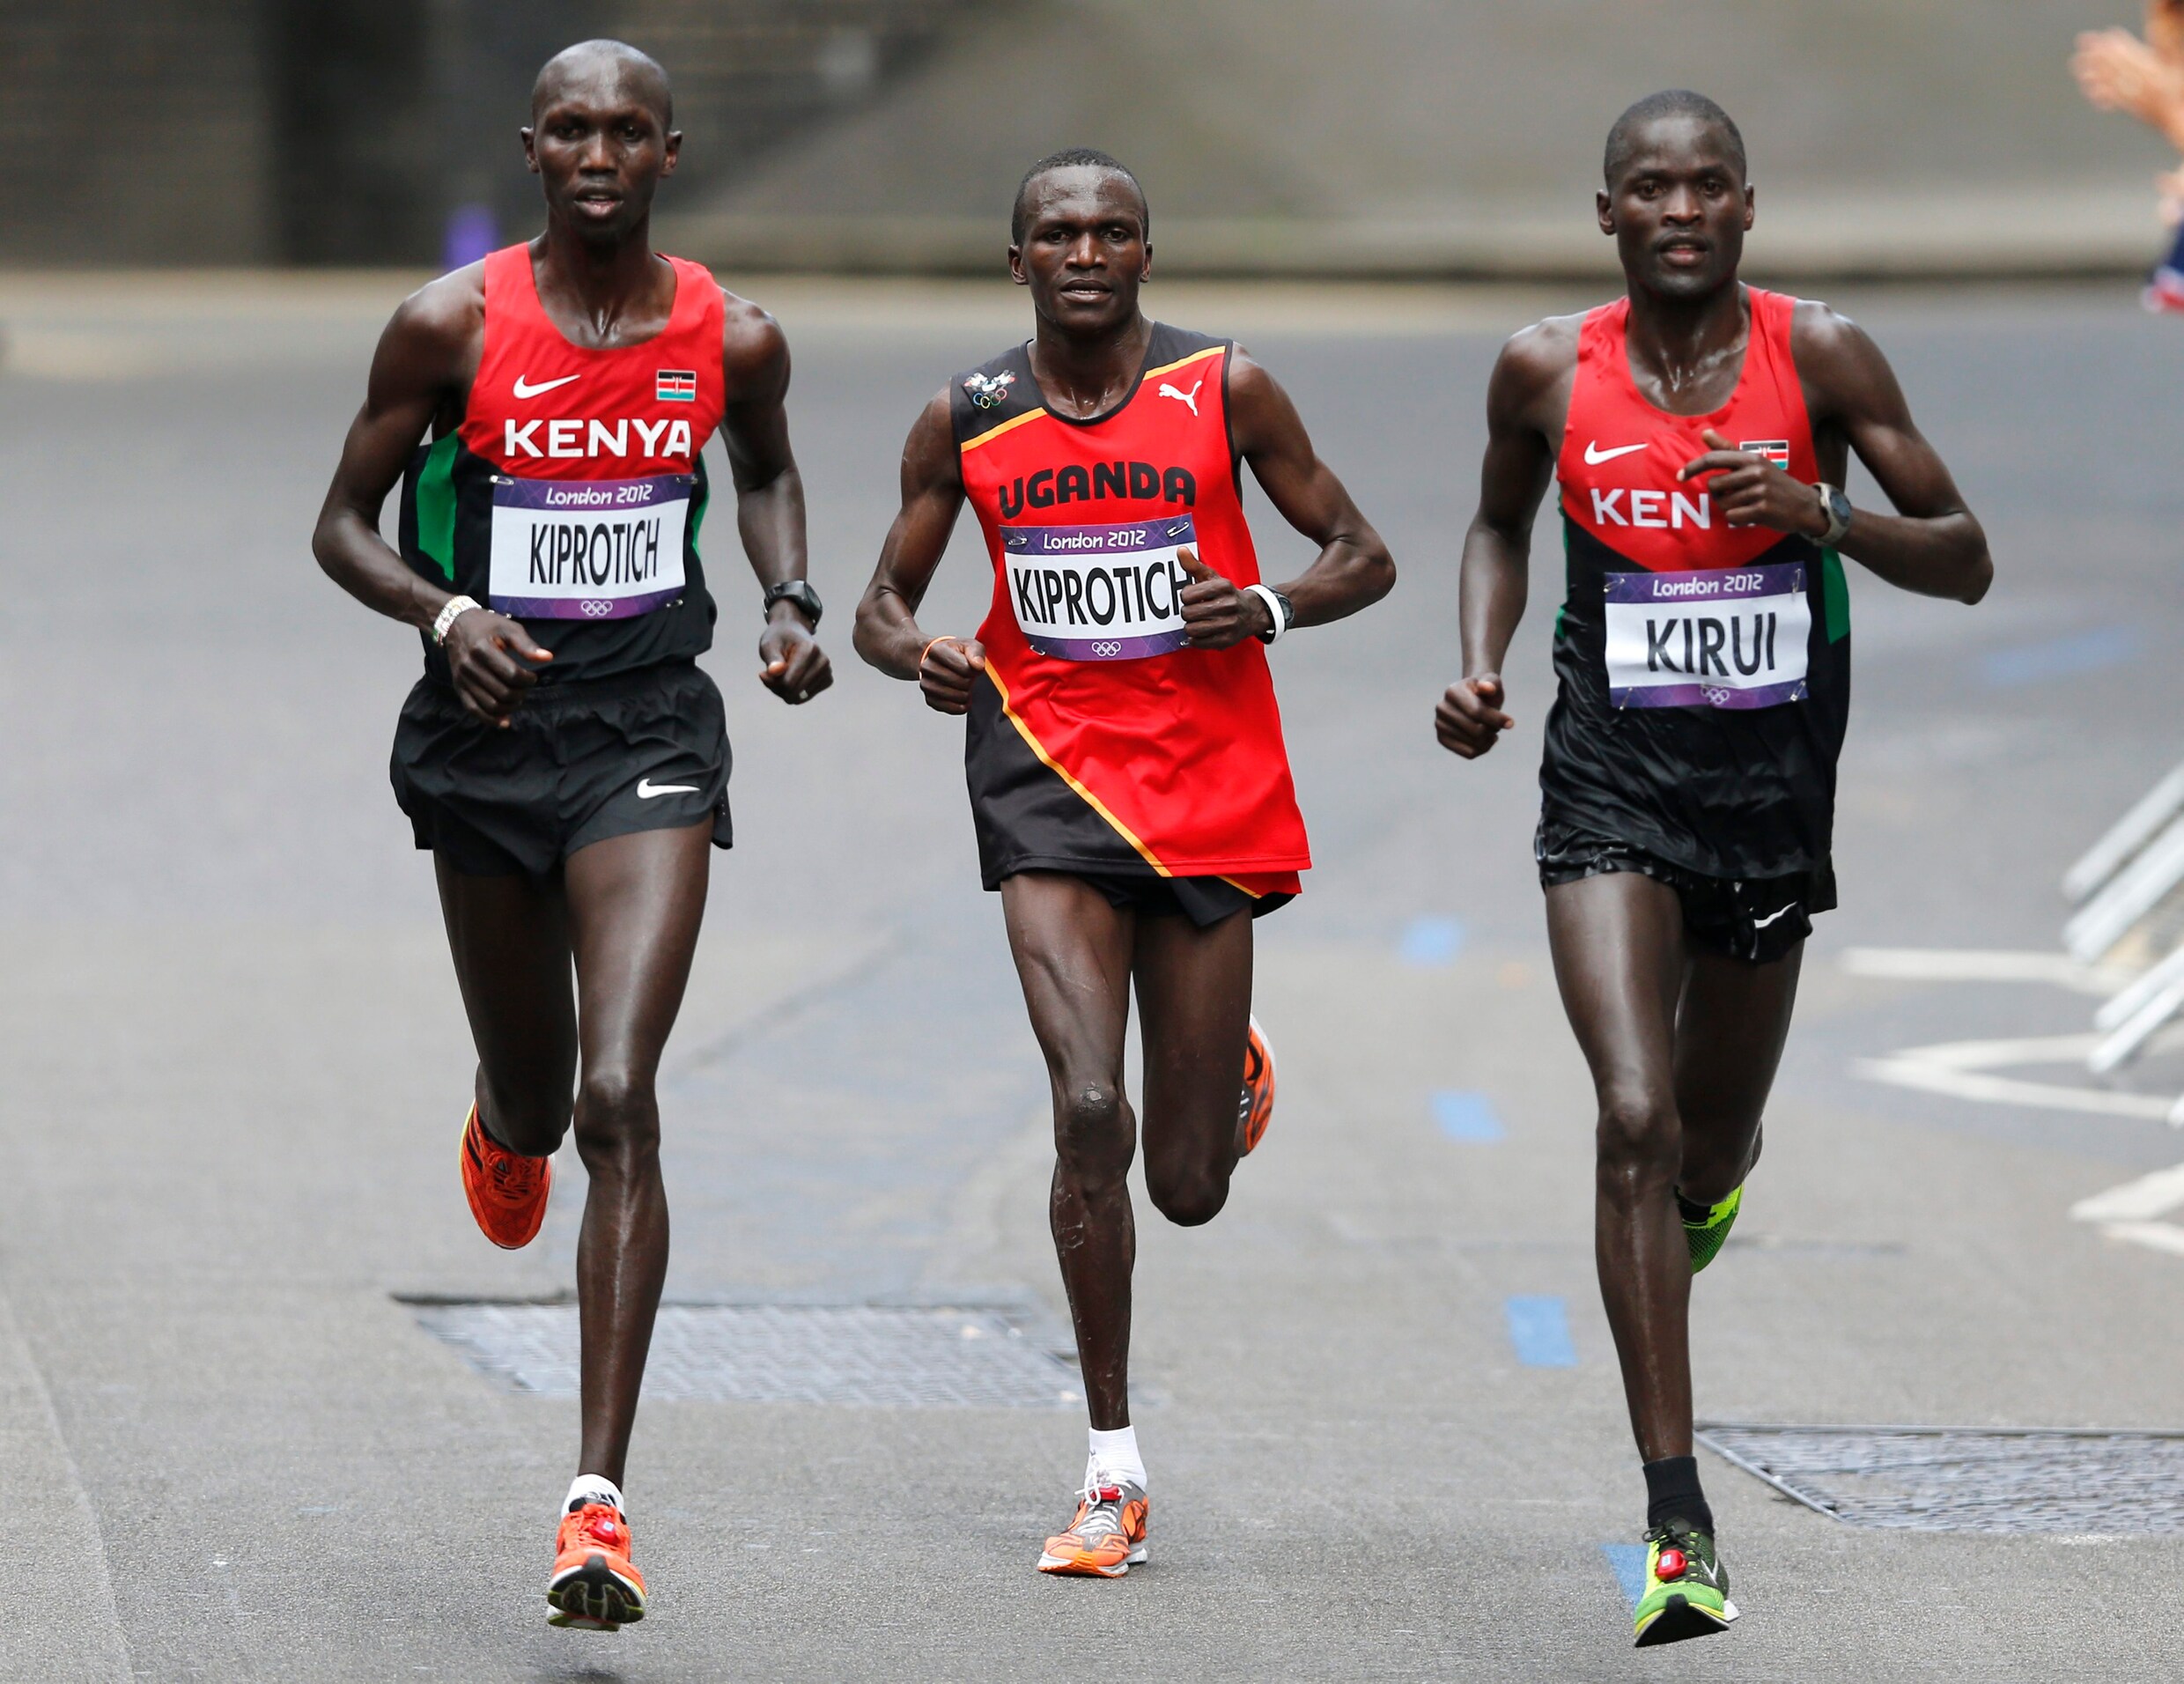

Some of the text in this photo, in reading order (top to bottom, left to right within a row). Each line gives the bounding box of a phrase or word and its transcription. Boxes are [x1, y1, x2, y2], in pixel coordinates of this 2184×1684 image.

[505, 418, 692, 458] KENYA
[545, 484, 653, 506] London 2012
[999, 461, 1197, 520] UGANDA
[1590, 488, 1758, 529] KEN
[529, 517, 660, 586] KIPROTICH
[1043, 529, 1147, 550] London 2012
[1013, 560, 1194, 625] KIPROTICH
[1652, 573, 1764, 597] London 2012
[1646, 612, 1776, 676] KIRUI
